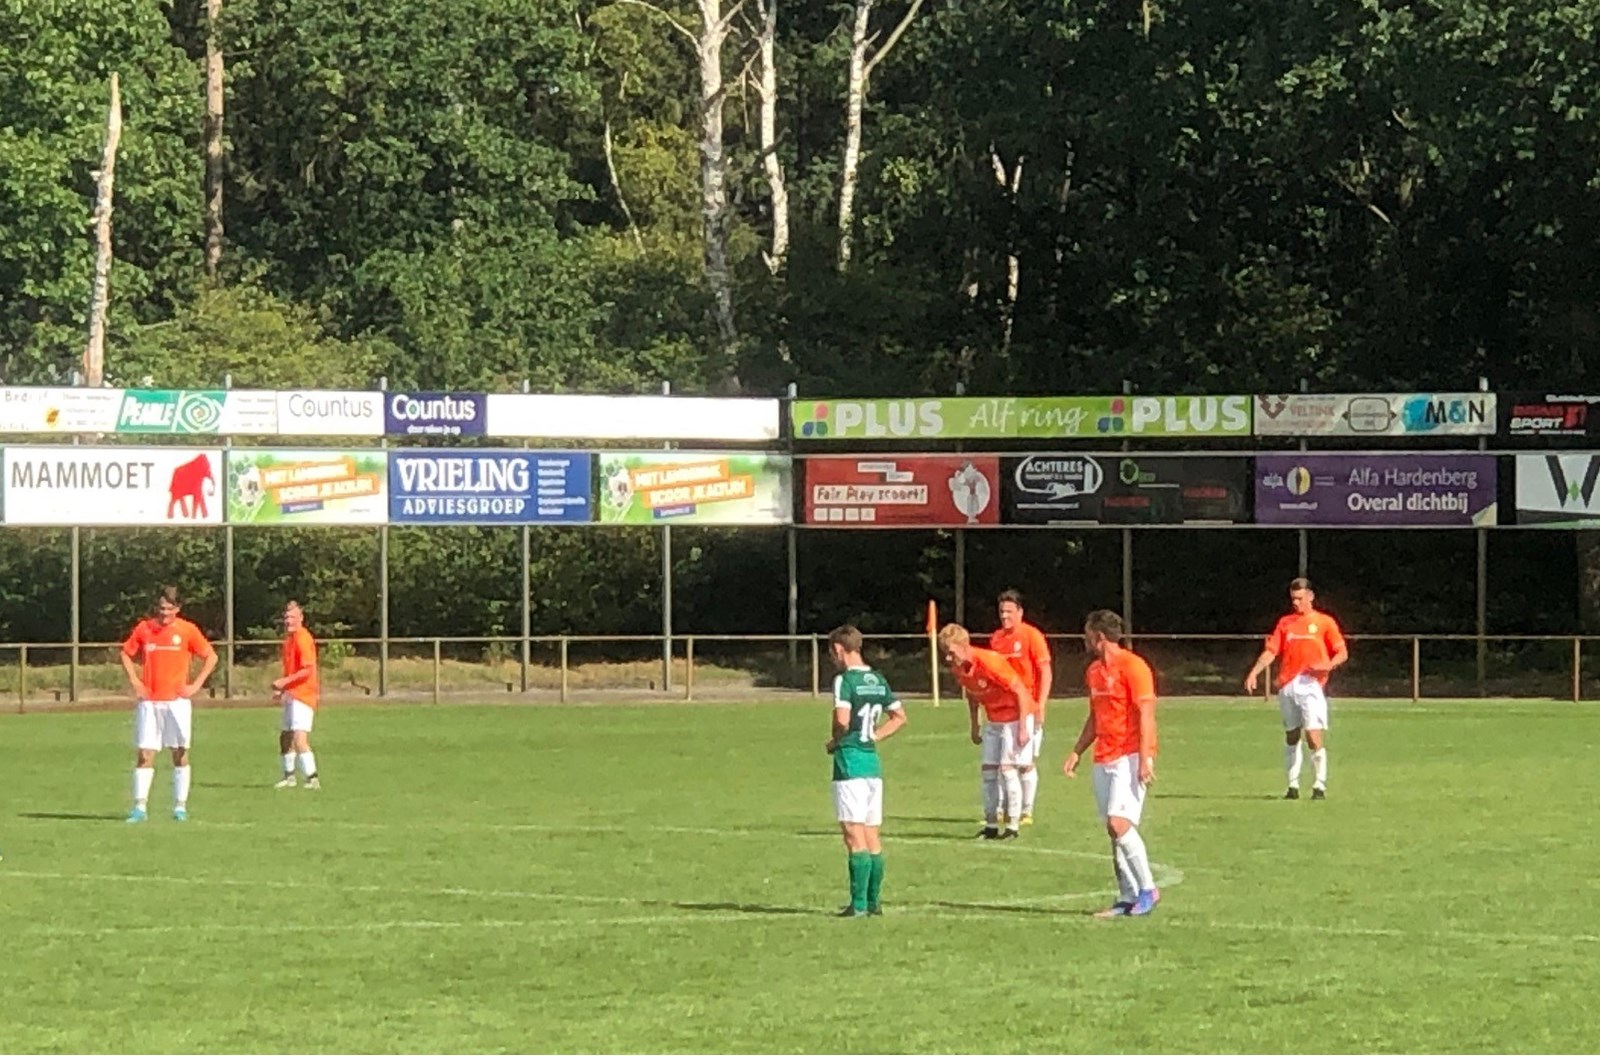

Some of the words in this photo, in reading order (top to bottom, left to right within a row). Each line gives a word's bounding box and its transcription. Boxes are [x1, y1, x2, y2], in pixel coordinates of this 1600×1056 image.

[288, 394, 373, 418] Countus
[391, 394, 476, 421] Countus
[835, 401, 944, 437] PLUS
[1132, 396, 1250, 432] PLUS
[1510, 417, 1564, 429] SPORT
[11, 461, 155, 489] MAMMOET
[396, 458, 530, 492] VRIELING
[1348, 467, 1379, 486] Alfa
[1385, 467, 1478, 489] Hardenberg
[817, 486, 841, 501] Fair
[846, 485, 874, 502] Play
[1347, 492, 1403, 512] Overal
[1406, 492, 1468, 513] dichtbij
[402, 499, 526, 515] ADVIESGROEP
